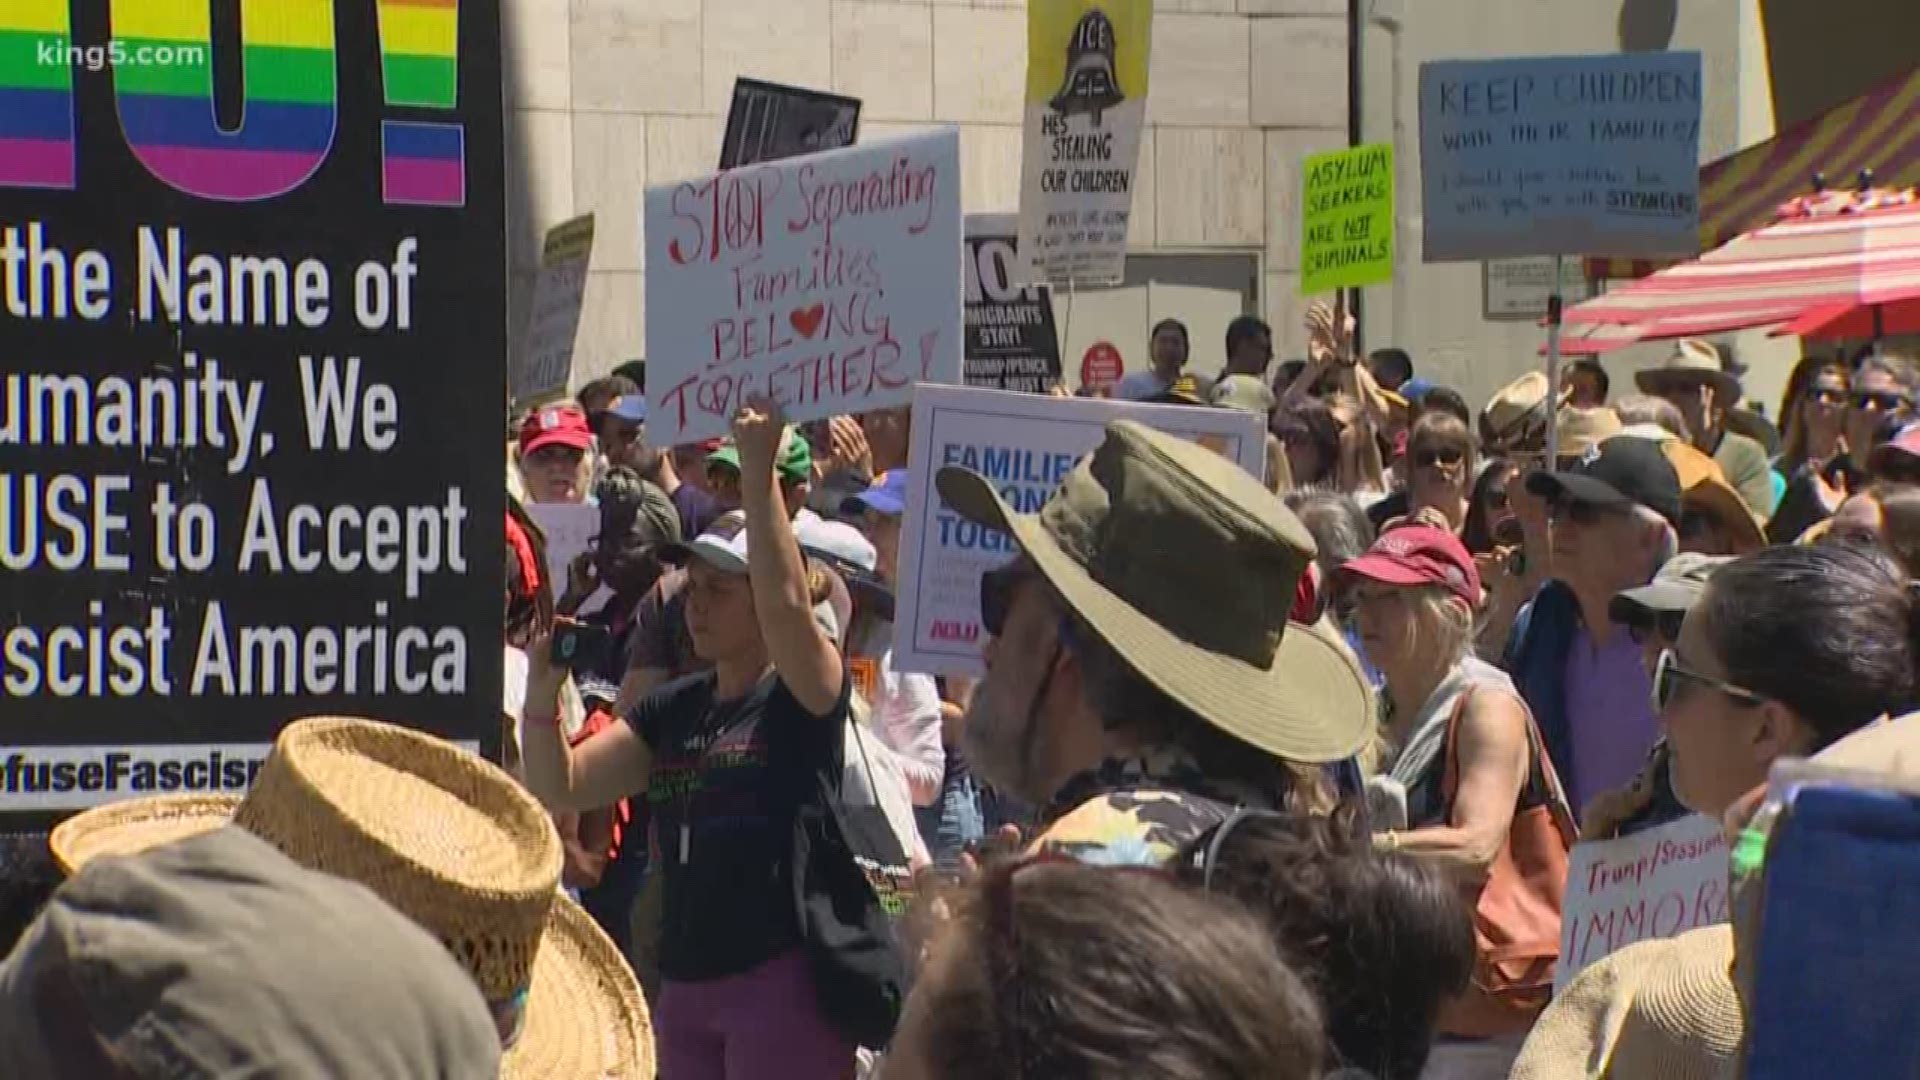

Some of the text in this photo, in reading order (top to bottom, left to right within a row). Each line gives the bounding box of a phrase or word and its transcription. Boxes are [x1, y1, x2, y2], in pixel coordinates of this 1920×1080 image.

[1079, 18, 1107, 50] ICE
[1440, 69, 1700, 115] KEEP CHILDREN
[1052, 132, 1113, 162] STEALING
[1041, 168, 1129, 194] OUR CHILDREN
[1308, 150, 1387, 189] ASYLUM
[668, 165, 784, 265] STOP
[1306, 181, 1386, 217] SEEKERS
[1308, 214, 1371, 246] ARE NOT
[0, 222, 418, 330] the Name of
[1304, 239, 1388, 276] CRIMINALS
[299, 355, 399, 452] We
[151, 482, 216, 572] to
[237, 476, 468, 599] Accept
[190, 600, 467, 697] America
[0, 750, 265, 793] fuseFascis
